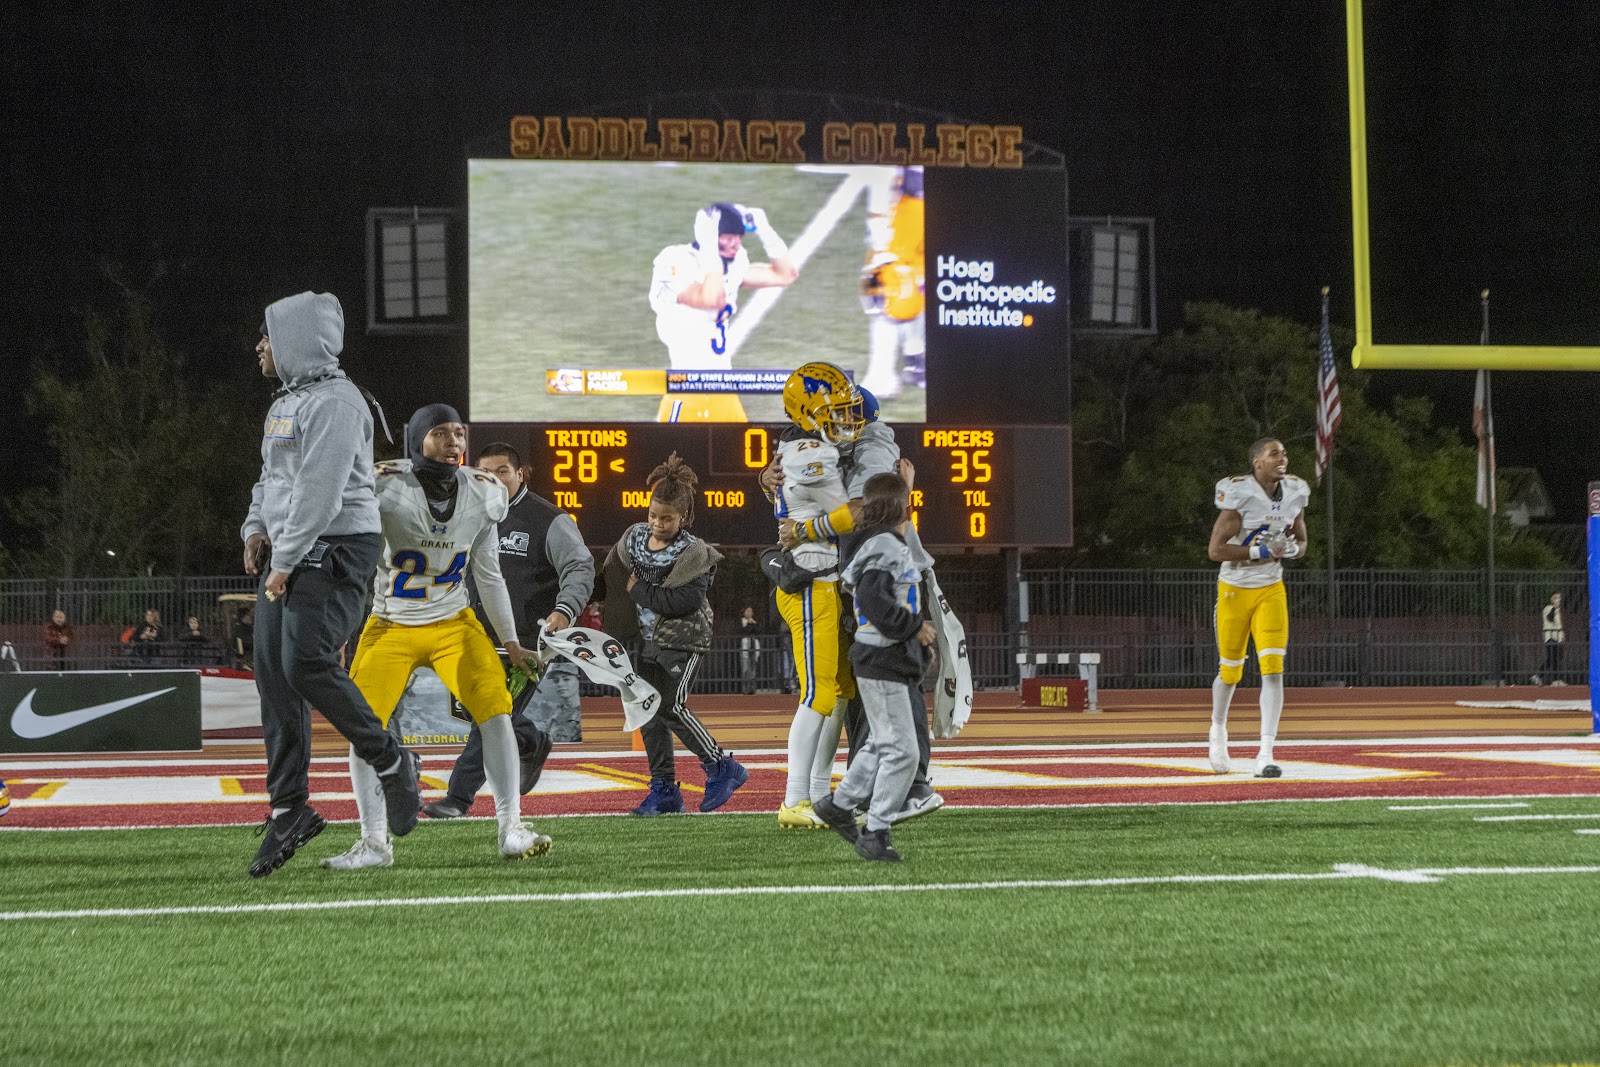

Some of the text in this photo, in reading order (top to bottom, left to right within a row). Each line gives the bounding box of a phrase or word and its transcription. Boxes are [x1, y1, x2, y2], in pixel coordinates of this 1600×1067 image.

[510, 116, 1024, 168] SADDLEBACK COLLEGE
[937, 254, 994, 282] Hoag
[937, 279, 1056, 307] Orthopedic
[700, 373, 722, 383] STATE
[723, 373, 757, 383] DIVISION
[682, 382, 703, 392] STATE
[545, 430, 627, 447] TRITONS
[923, 430, 994, 447] PACERS
[553, 450, 598, 483] 28
[950, 450, 992, 483] 35
[553, 491, 582, 508] TOL
[622, 491, 651, 508] DOW
[908, 490, 924, 507] TR
[963, 490, 991, 507] TOL
[970, 512, 986, 538] 0
[421, 540, 455, 549] GRANT
[391, 548, 468, 601] 24
